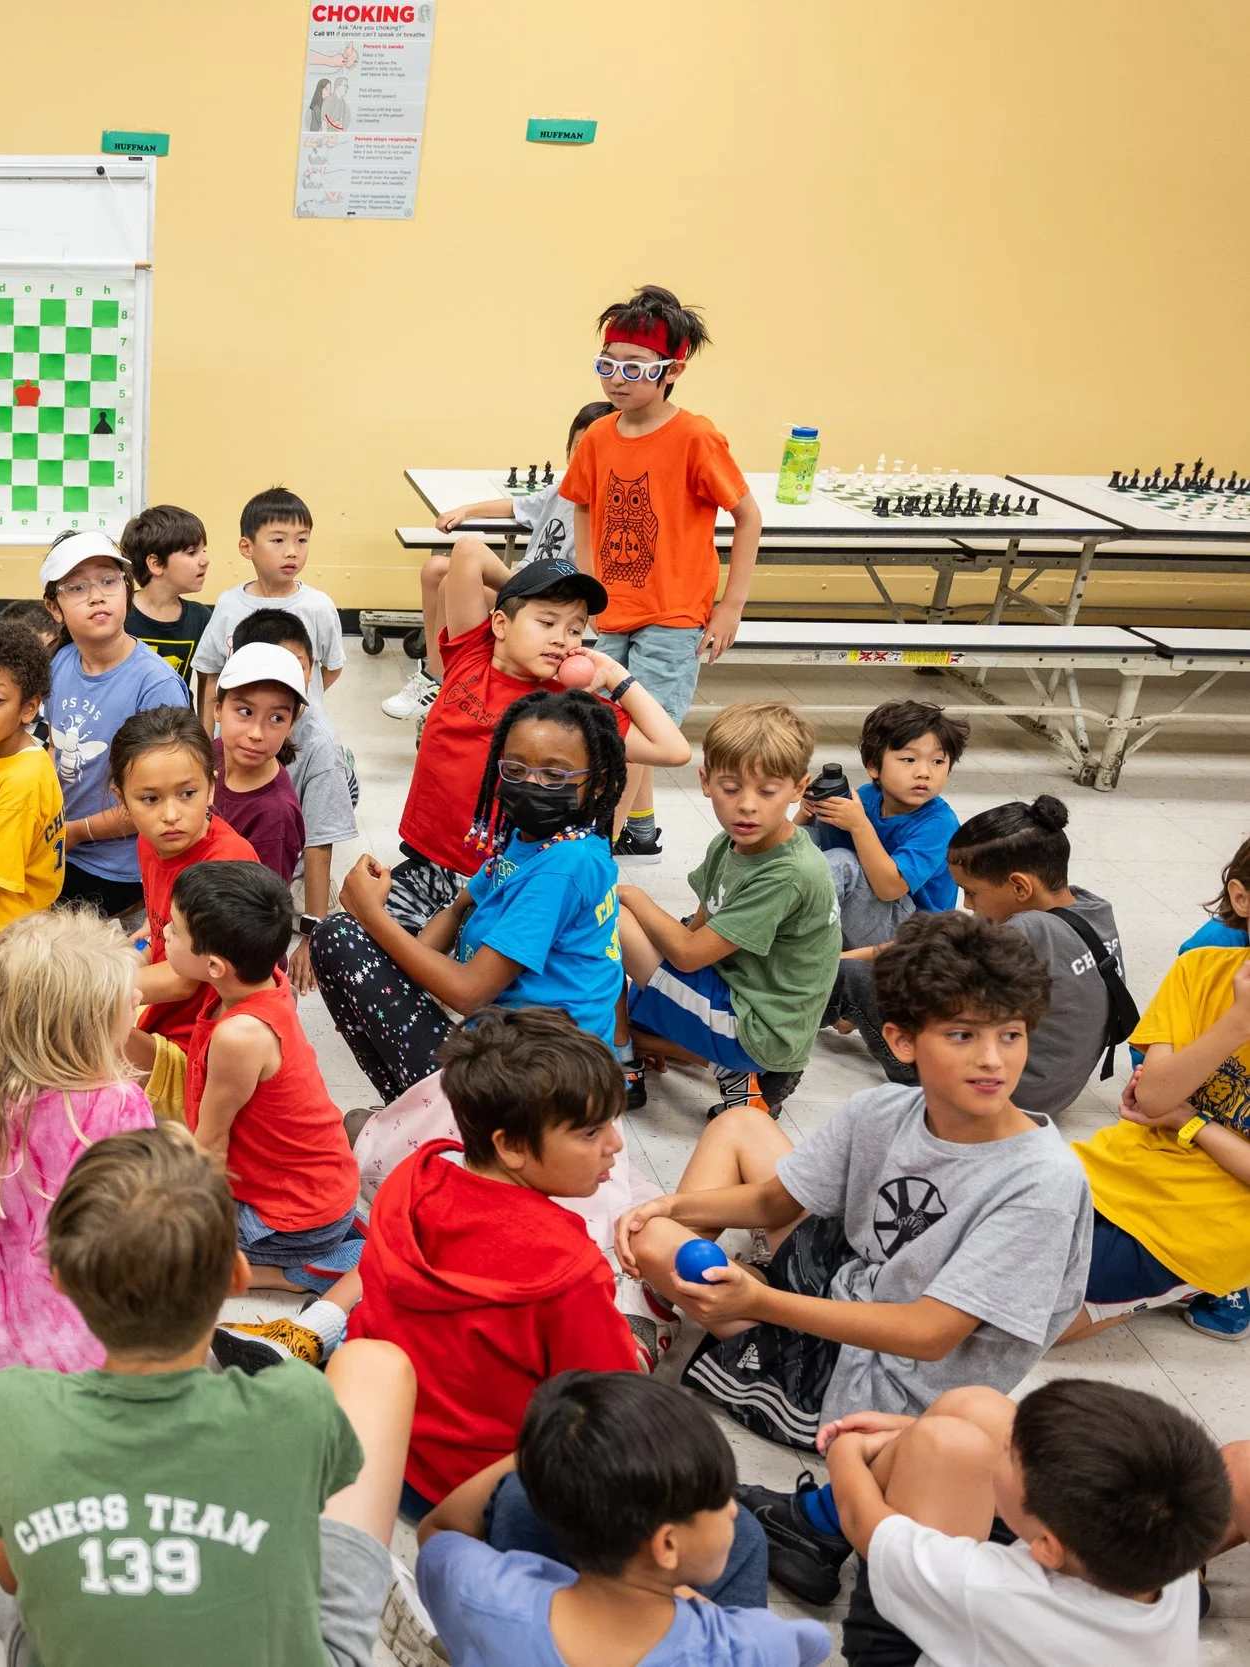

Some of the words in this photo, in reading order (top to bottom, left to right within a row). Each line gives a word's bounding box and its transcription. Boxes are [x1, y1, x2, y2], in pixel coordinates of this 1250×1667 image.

[312, 5, 415, 22] CHOKING
[540, 131, 584, 140] HUFFMAN
[114, 143, 157, 152] HUFFMAN
[50, 284, 55, 292] f
[76, 287, 82, 296] g
[103, 286, 111, 294] h
[46, 516, 51, 525] f
[71, 519, 78, 527] g
[98, 515, 106, 525] h
[610, 542, 620, 550] PS
[626, 543, 639, 551] 34
[62, 697, 77, 711] PS
[736, 1342, 757, 1369] adidas
[14, 1493, 130, 1555] CHESS
[144, 1492, 271, 1555] TEAM
[78, 1536, 202, 1596] 139
